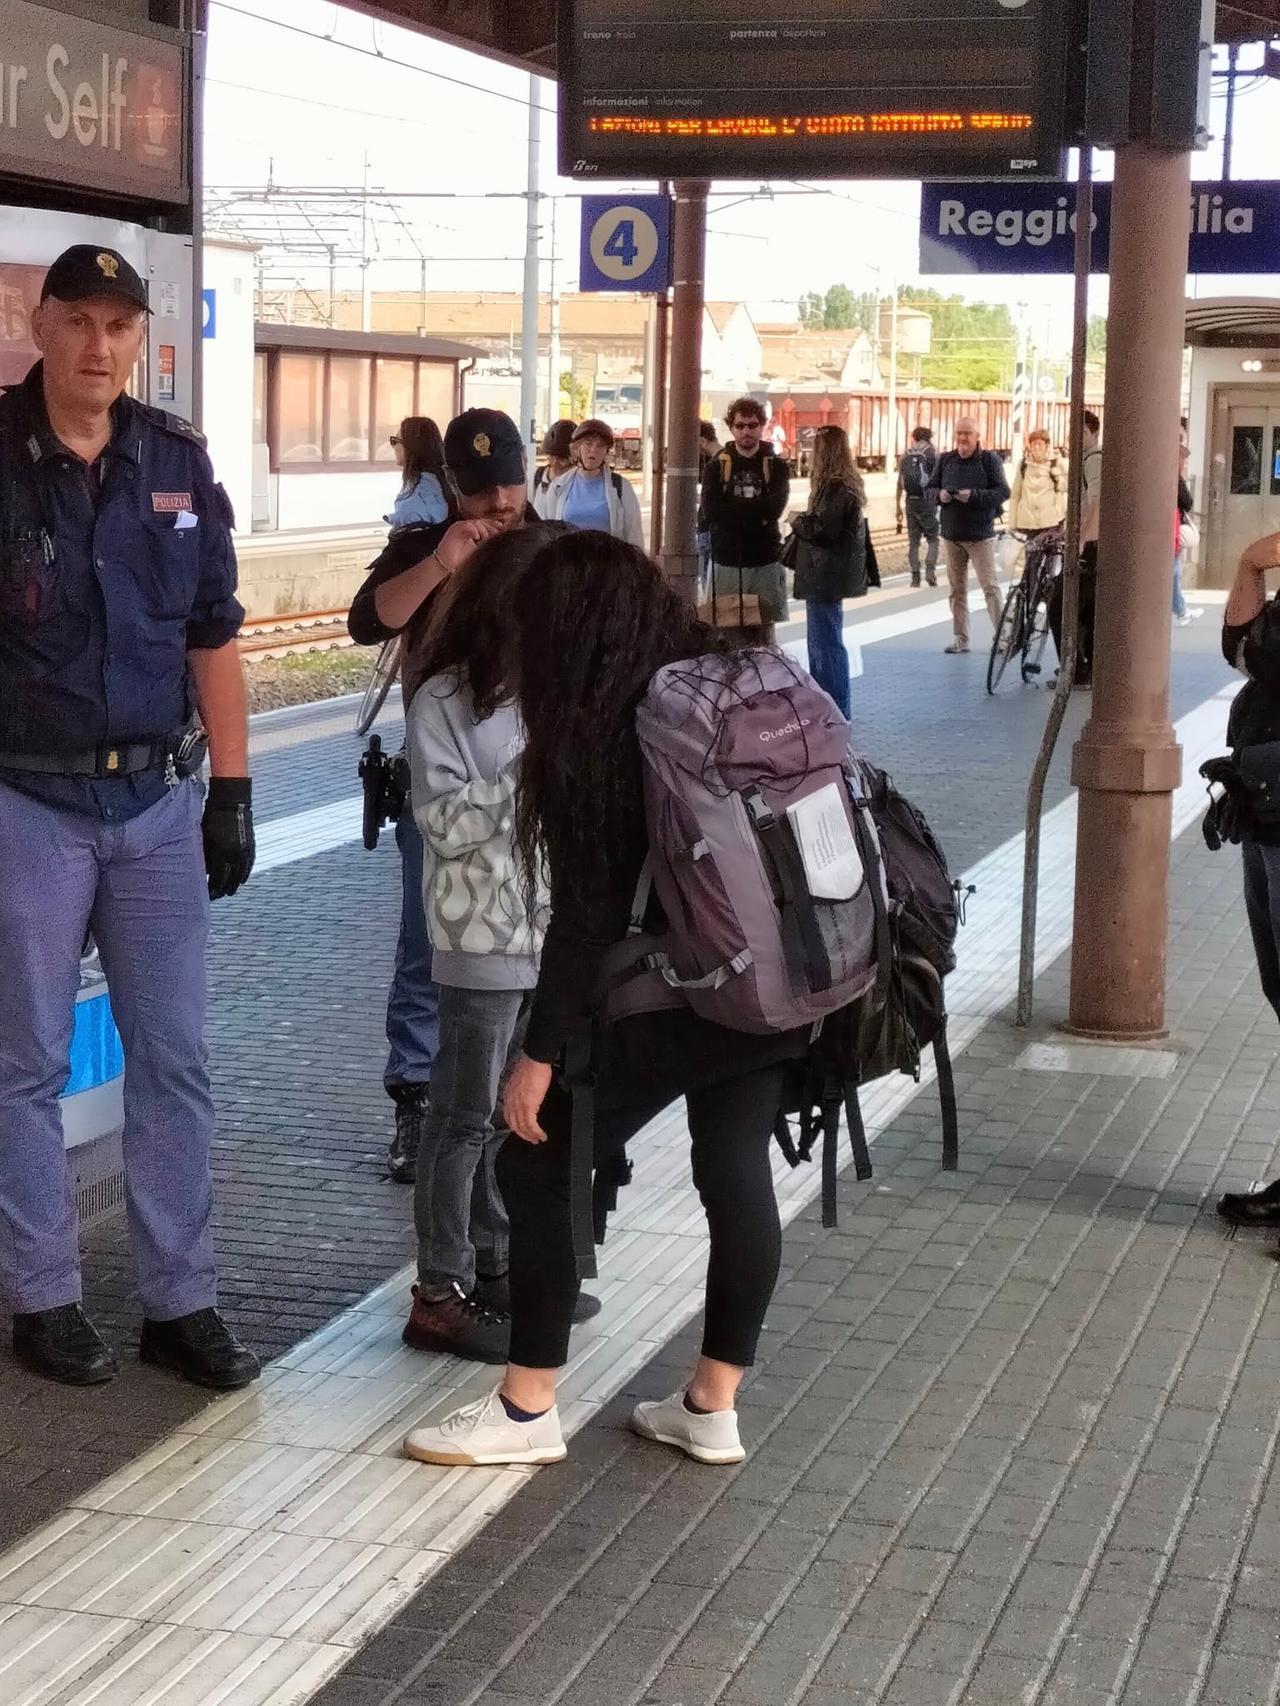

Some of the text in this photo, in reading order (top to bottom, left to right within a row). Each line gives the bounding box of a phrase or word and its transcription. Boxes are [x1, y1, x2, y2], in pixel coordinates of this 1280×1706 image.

[729, 30, 777, 40] partenza
[0, 43, 128, 150] r Self
[583, 96, 649, 106] informazioni
[938, 197, 1098, 246] Reggio
[602, 219, 639, 267] 4
[154, 496, 190, 509] POLIZIA
